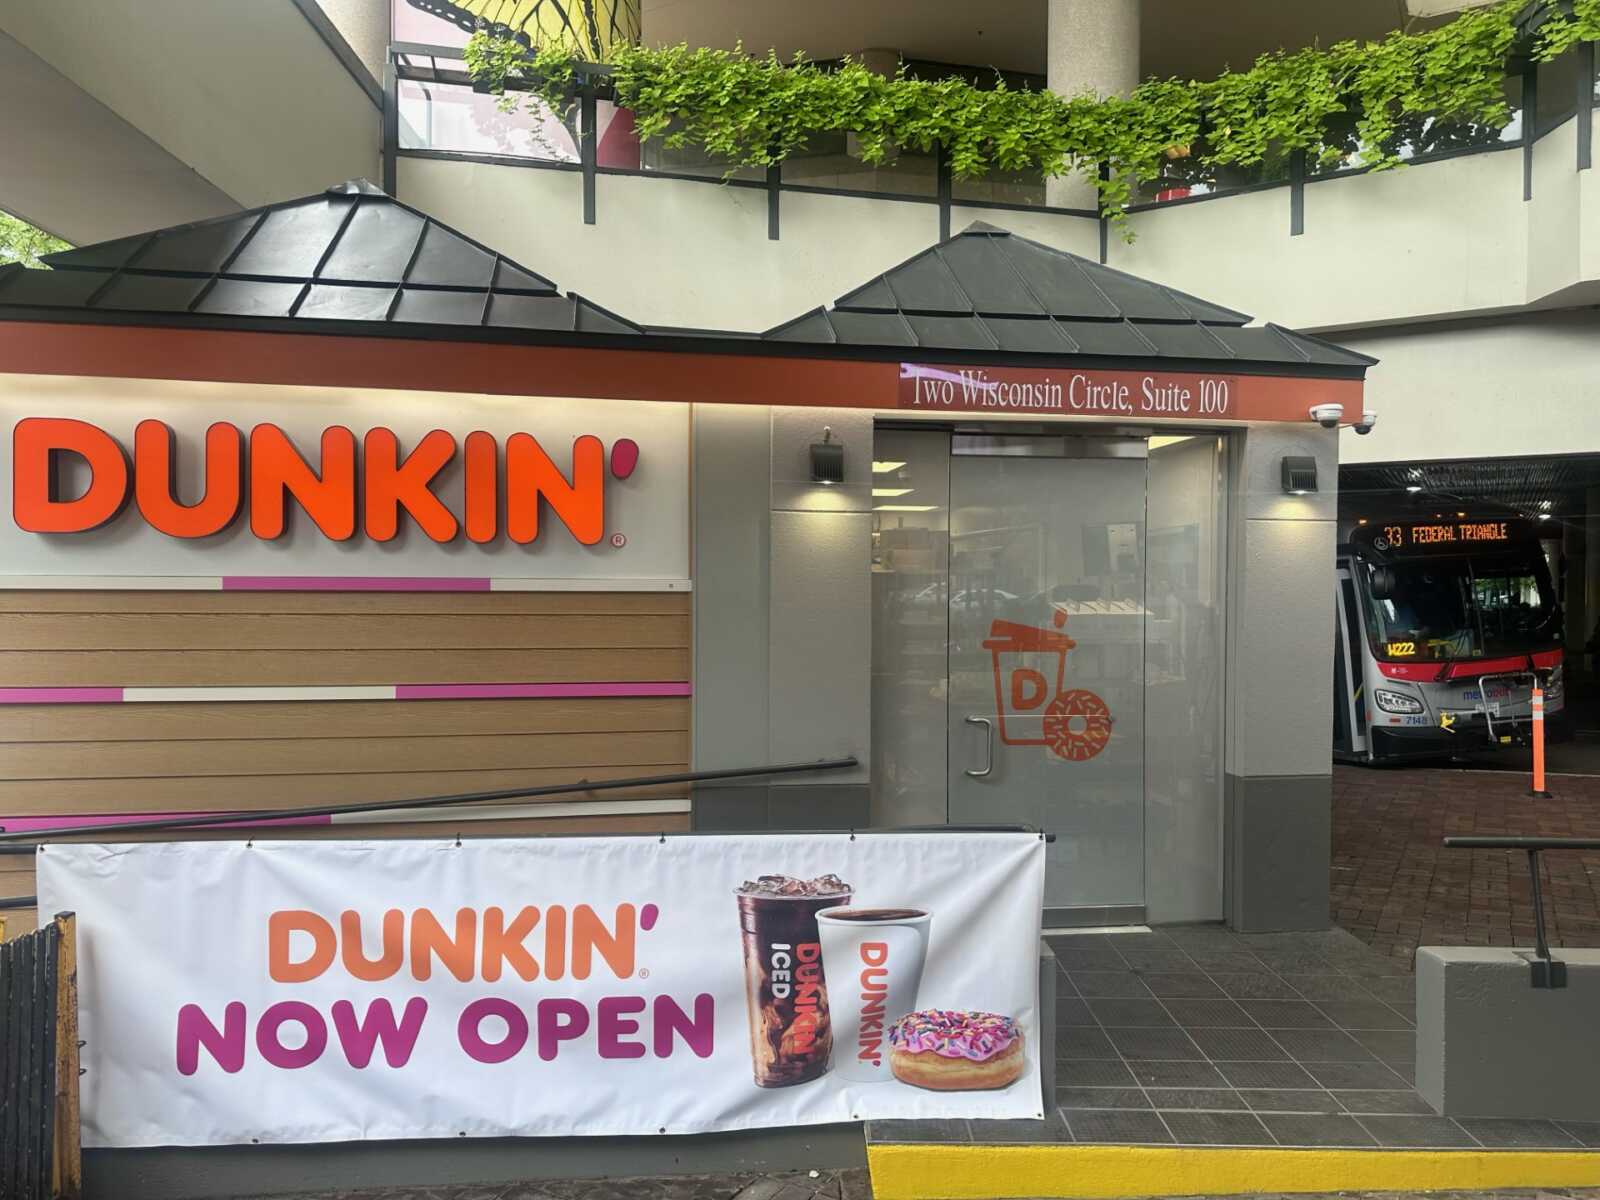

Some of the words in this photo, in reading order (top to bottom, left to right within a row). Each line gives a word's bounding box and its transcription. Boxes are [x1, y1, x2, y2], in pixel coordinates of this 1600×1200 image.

[912, 368, 953, 404] Two
[960, 370, 1062, 408] Wisconsin
[1069, 374, 1133, 414] Circle,
[1141, 377, 1190, 412] Suite
[1199, 380, 1228, 413] 100
[13, 417, 639, 546] DUNKIN'
[1384, 526, 1402, 547] 33
[1412, 525, 1456, 544] FEDERAL
[1459, 522, 1507, 541] TRIANGLE
[1011, 669, 1047, 711] D
[268, 902, 659, 983] DUNKIN'
[771, 943, 791, 1000] ICED
[176, 996, 428, 1076] NOW
[457, 992, 715, 1064] OPEN
[857, 942, 889, 1068] DUNKIN'
